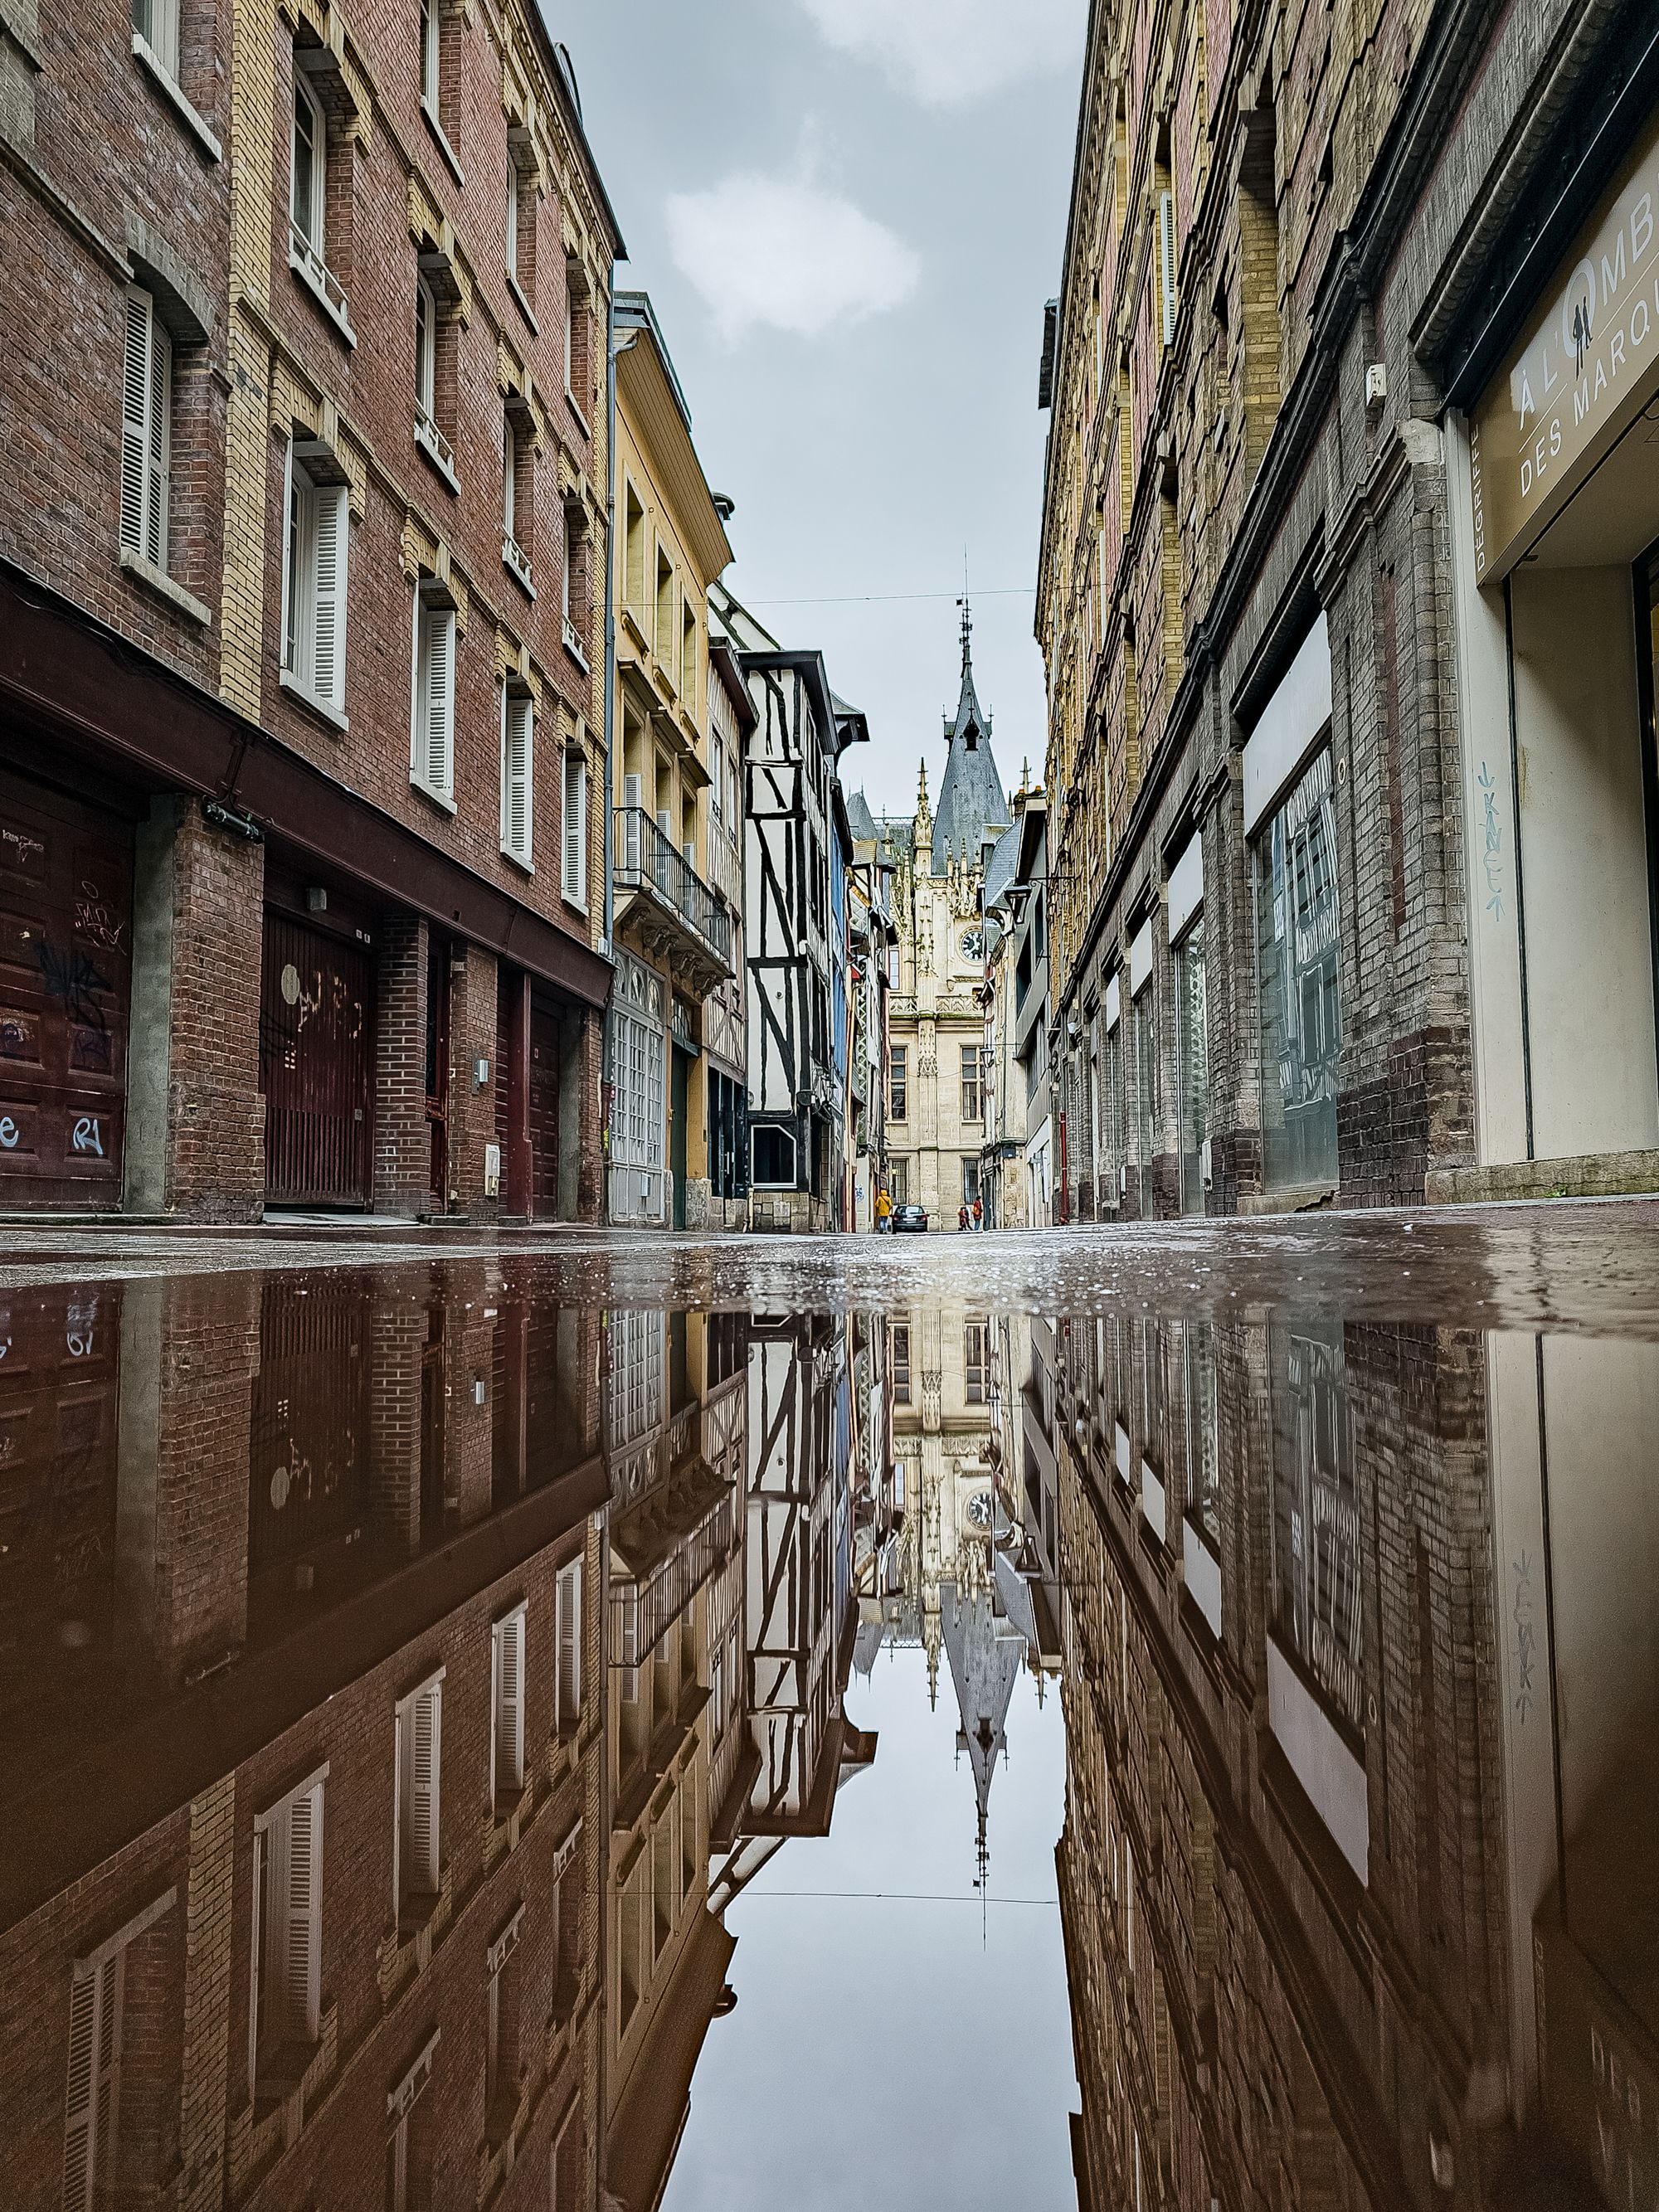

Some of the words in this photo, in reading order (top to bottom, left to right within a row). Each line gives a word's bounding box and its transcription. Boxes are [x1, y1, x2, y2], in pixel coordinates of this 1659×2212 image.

[1520, 418, 1563, 498] DES
[1573, 278, 1659, 427] MARQ
[1543, 174, 1659, 393] L'OMB
